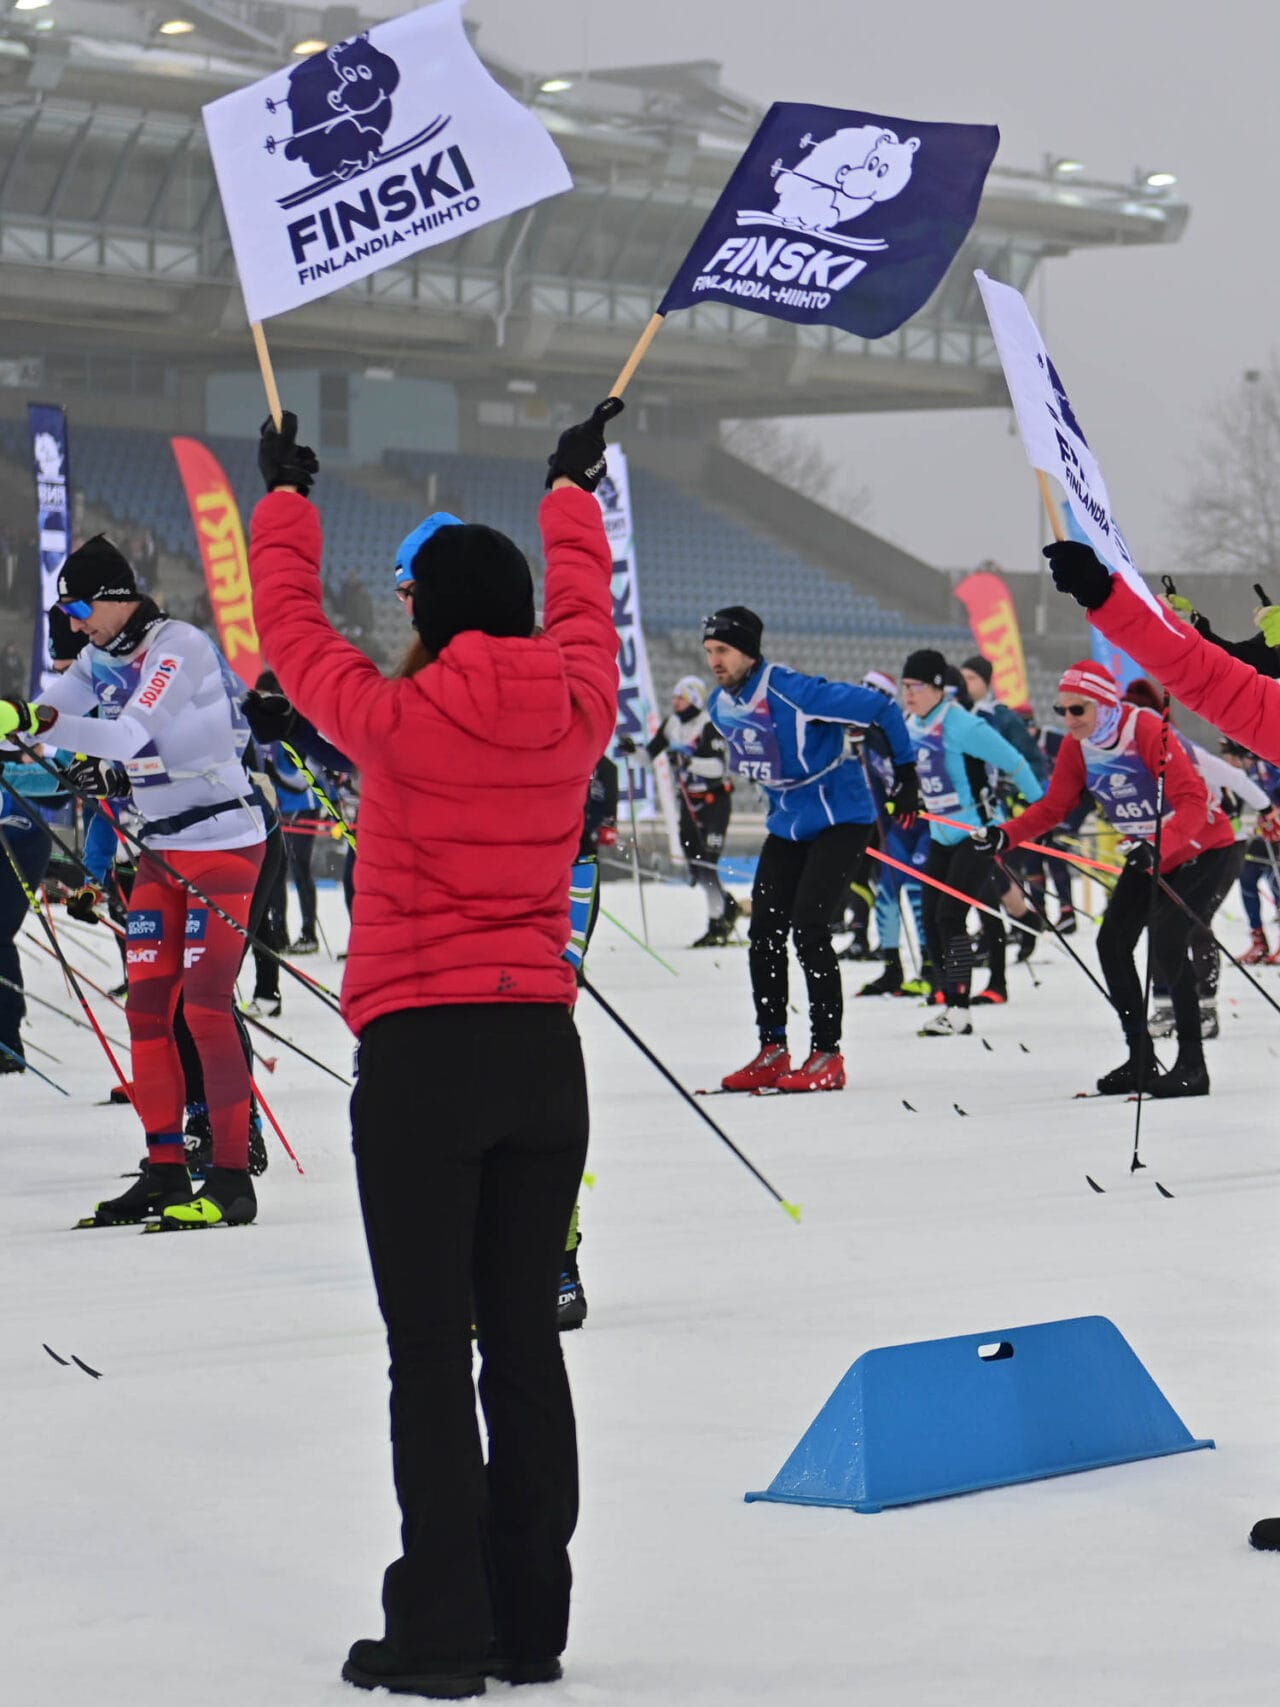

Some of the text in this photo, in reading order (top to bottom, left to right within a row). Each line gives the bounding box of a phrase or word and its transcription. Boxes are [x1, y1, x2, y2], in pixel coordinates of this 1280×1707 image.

[287, 144, 476, 265] FINSKI
[298, 195, 481, 286] FINLANDIA-HIIHTO
[702, 236, 867, 291] FINSKI
[692, 275, 832, 310] FINLANDIA-HIIHTO
[139, 671, 171, 709] LOTOS
[738, 760, 772, 780] 575
[1115, 799, 1154, 819] 461
